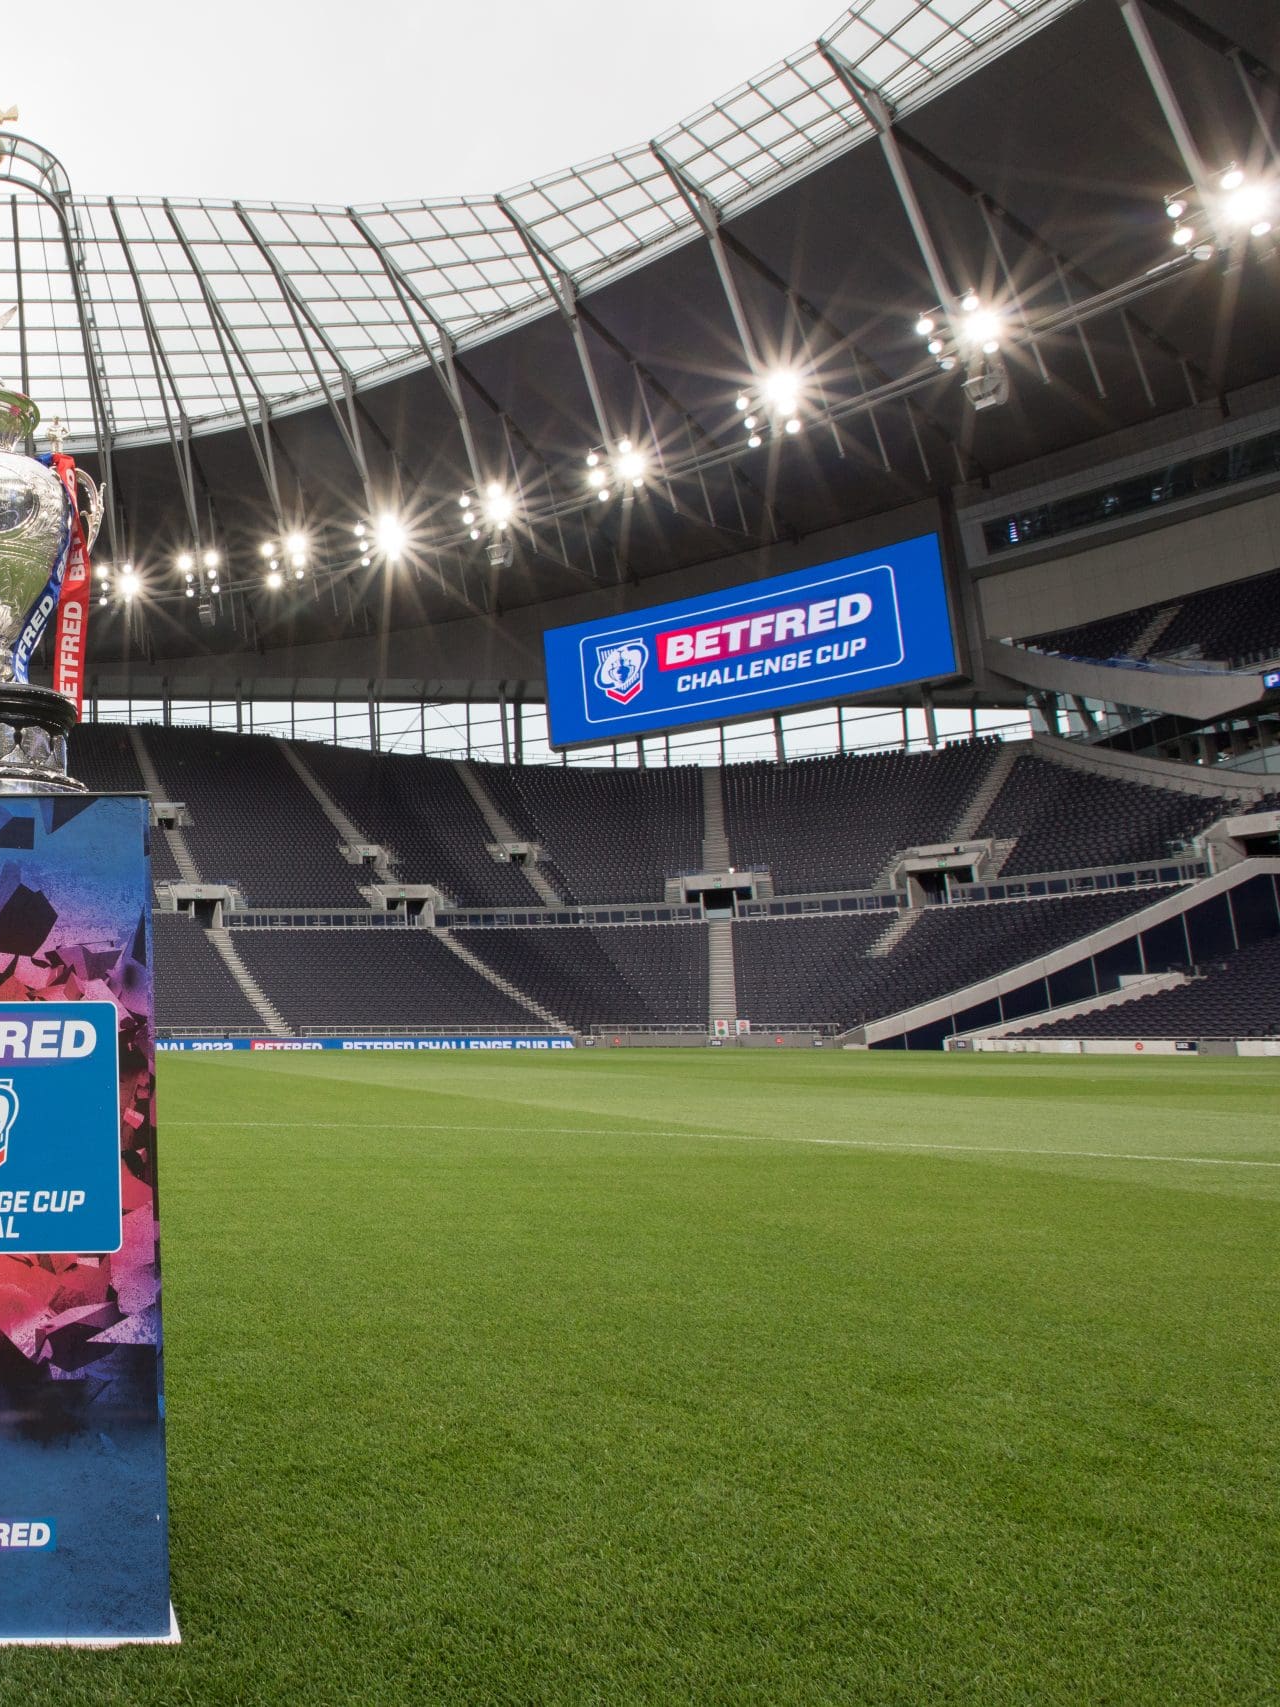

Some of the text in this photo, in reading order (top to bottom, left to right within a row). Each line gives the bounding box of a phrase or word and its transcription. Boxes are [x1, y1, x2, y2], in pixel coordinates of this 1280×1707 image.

[60, 601, 83, 712] ETFRED
[665, 592, 872, 666] BETFRED
[676, 637, 867, 693] CHALLENGE CUP
[32, 1190, 85, 1213] CUP
